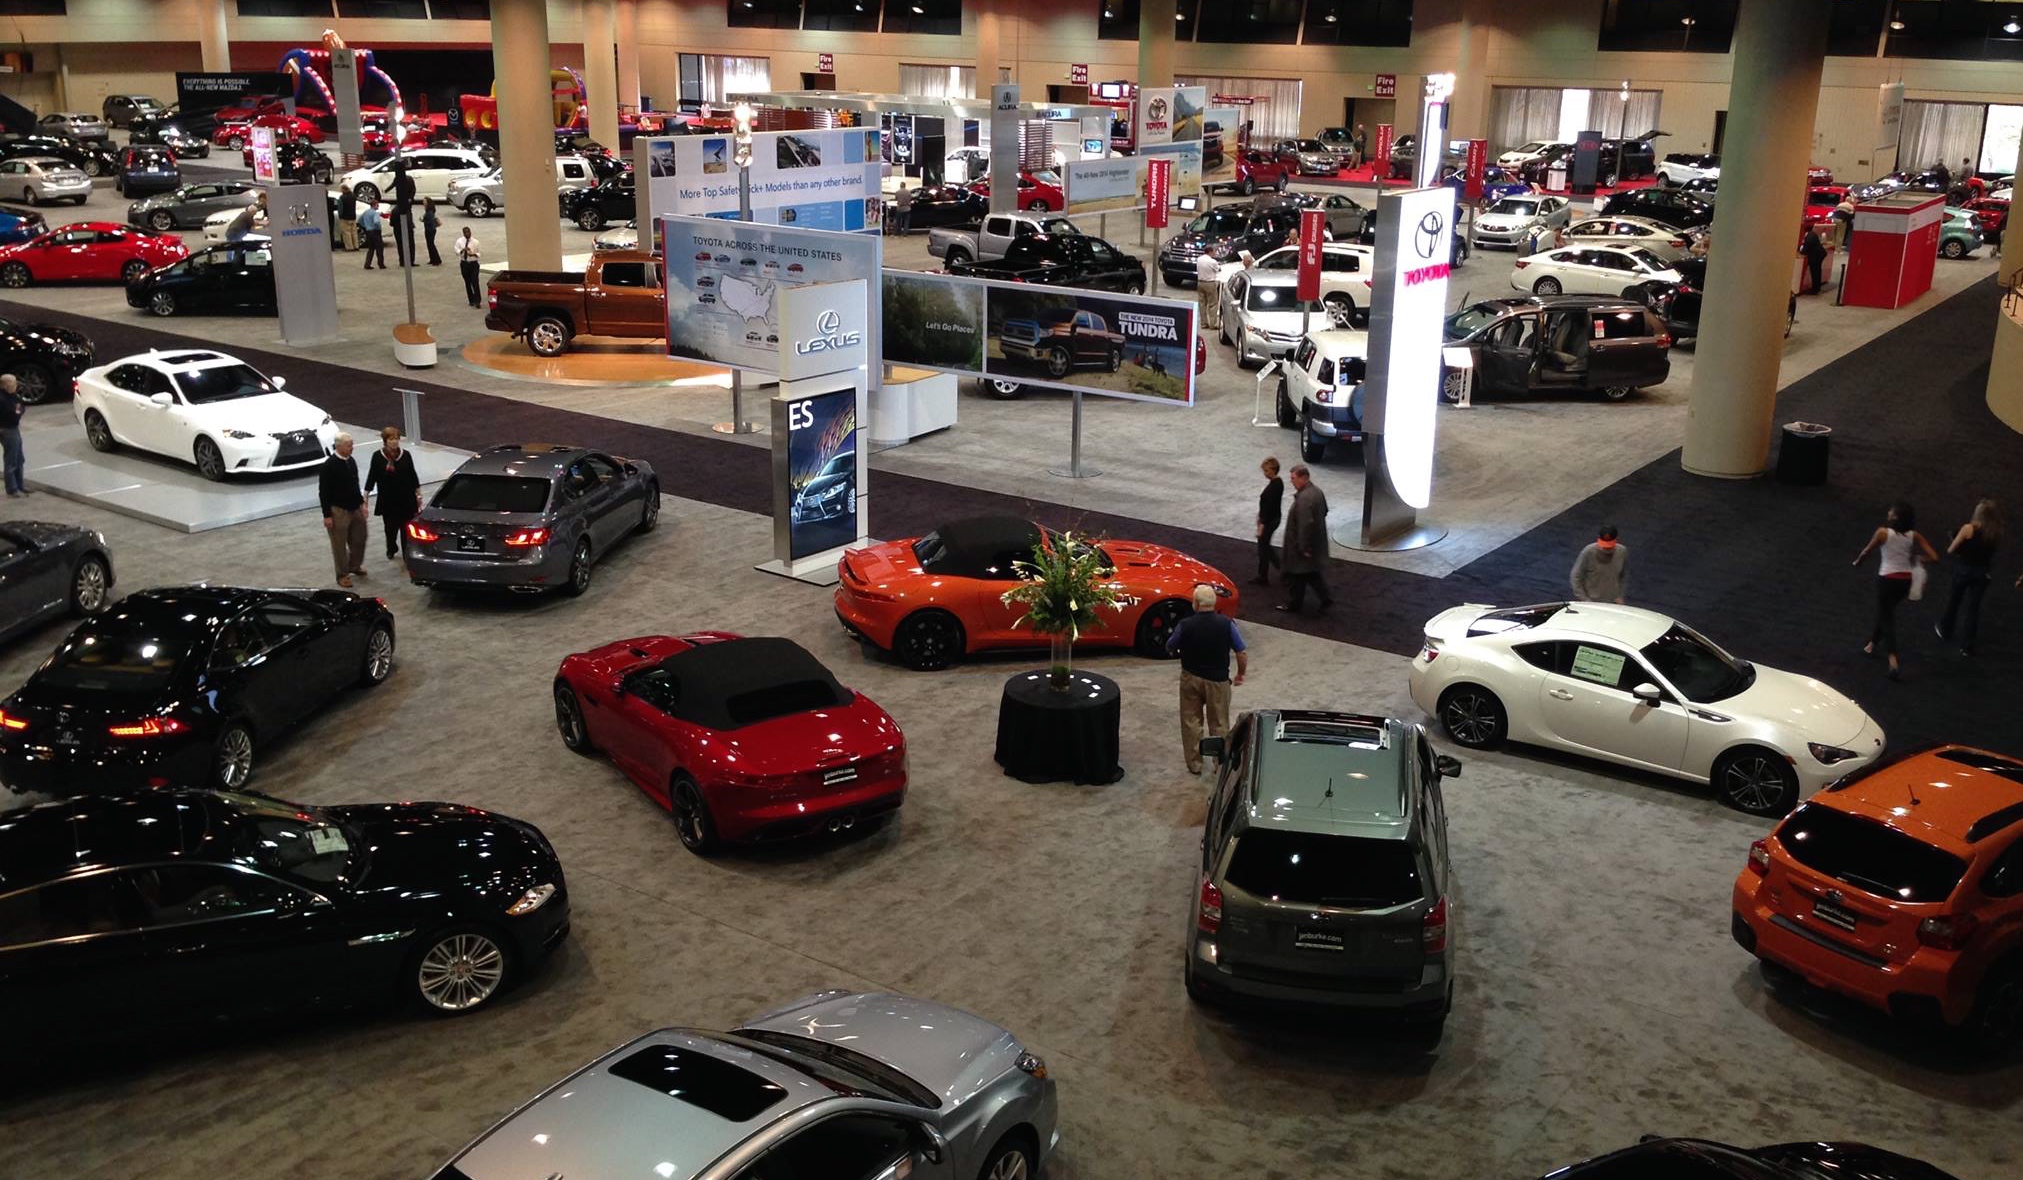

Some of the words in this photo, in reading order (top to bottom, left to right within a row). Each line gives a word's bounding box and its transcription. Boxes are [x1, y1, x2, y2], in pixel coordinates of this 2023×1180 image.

[1072, 74, 1086, 82] Exit
[1376, 86, 1394, 94] Exit
[1146, 122, 1167, 130] TOYOTA
[680, 189, 701, 199] More
[703, 187, 717, 198] Top
[719, 185, 740, 196] Safet
[765, 181, 791, 192] Models
[793, 180, 808, 189] than
[810, 180, 822, 189] any
[823, 177, 841, 187] other
[282, 228, 322, 237] HONDA
[693, 236, 722, 247] TOYOTA
[725, 240, 758, 252] ACROSS
[760, 244, 776, 254] THE
[778, 246, 809, 258] UNITED
[811, 249, 842, 262] STATES
[1307, 243, 1316, 265] FJ
[1404, 262, 1452, 287] TOYOTA
[942, 323, 952, 331] Go
[953, 325, 976, 334] Places
[1119, 321, 1178, 341] TUNDRA
[1155, 317, 1174, 325] TOYOTA
[795, 330, 861, 356] LEXUS
[789, 400, 814, 430] ES
